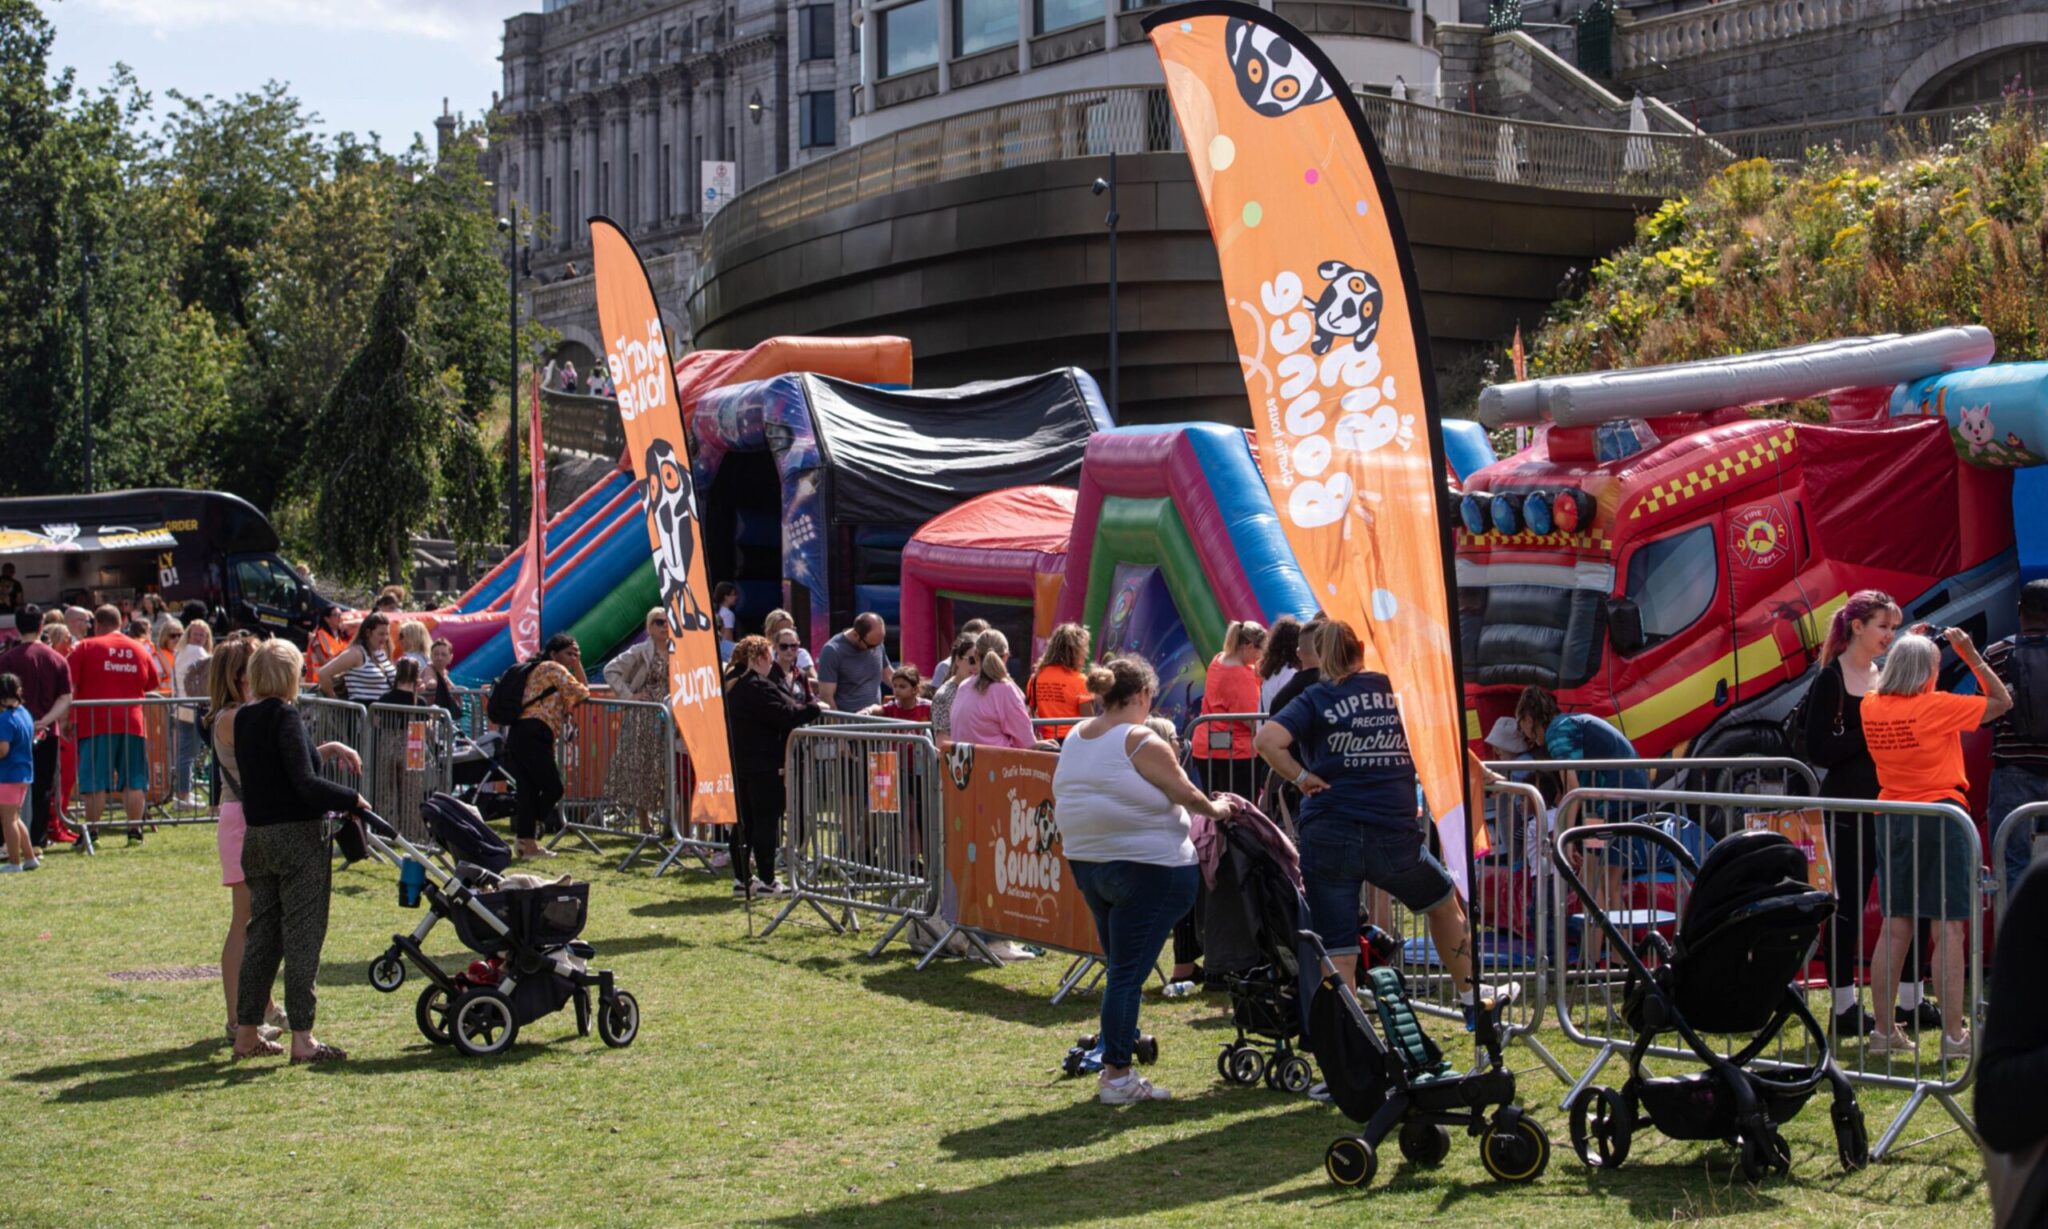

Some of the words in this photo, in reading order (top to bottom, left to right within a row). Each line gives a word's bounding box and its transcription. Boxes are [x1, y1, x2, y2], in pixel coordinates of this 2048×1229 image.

[1744, 510, 1762, 521] FIRE
[104, 660, 138, 674] Events
[1323, 692, 1397, 724] SUPERD
[1343, 757, 1391, 768] COPPER
[1010, 798, 1038, 853] Big
[994, 836, 1061, 895] Bounce
